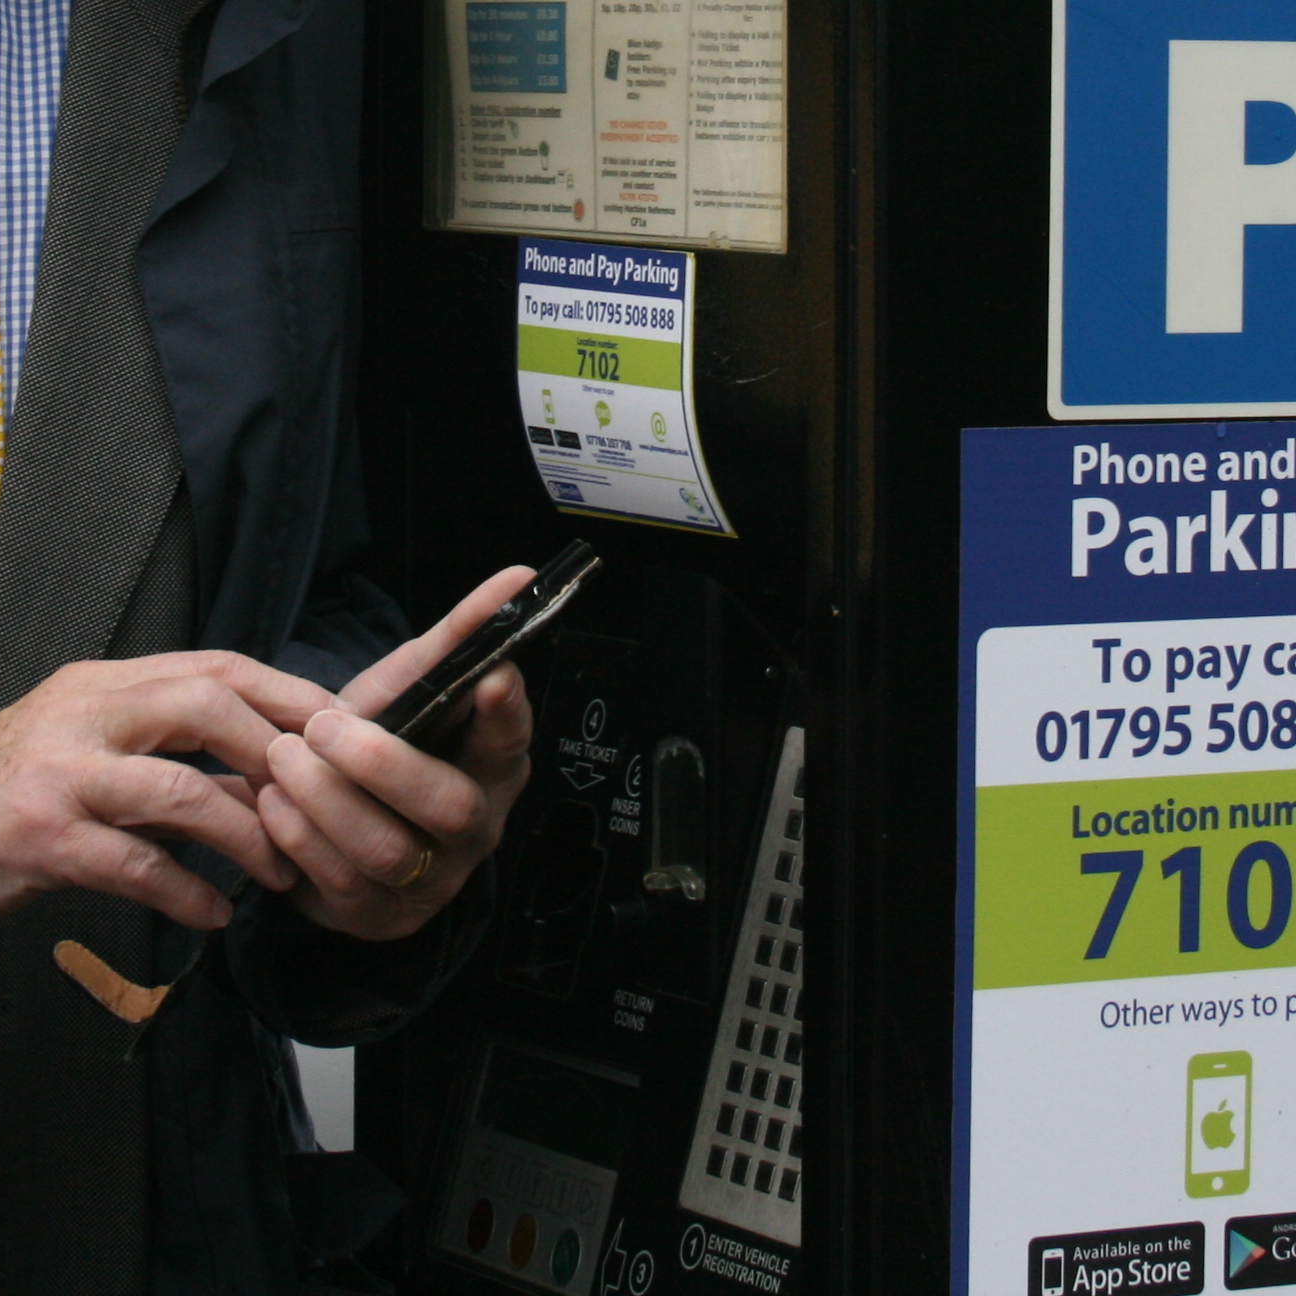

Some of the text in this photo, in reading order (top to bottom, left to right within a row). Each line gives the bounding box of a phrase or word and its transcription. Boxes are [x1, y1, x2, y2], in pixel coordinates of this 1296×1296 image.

[524, 247, 680, 293] Phone and Pay Parking
[525, 294, 675, 332] To pay call: 01795 508 888
[576, 348, 620, 382] 7102
[1072, 442, 1207, 485] Phone
[1217, 438, 1296, 482] and
[1091, 637, 1152, 684] To
[1165, 644, 1252, 693] pay
[588, 710, 599, 730] 4
[1035, 704, 1192, 763] 01795
[558, 738, 619, 764] TAKE TICKET
[610, 796, 641, 817] INSER
[1071, 797, 1219, 839] Location
[609, 815, 641, 837] COINS
[613, 988, 655, 1014] RETURN
[1099, 998, 1174, 1028] Other
[1181, 995, 1244, 1027] ways
[1251, 993, 1278, 1018] to
[613, 1009, 646, 1032] COINS
[707, 1234, 791, 1276] ENTER VEHICLE
[1072, 1235, 1192, 1262] Available on the
[635, 1262, 647, 1285] 3
[702, 1253, 782, 1295] REGISTRATION
[1072, 1257, 1192, 1294] App Store
